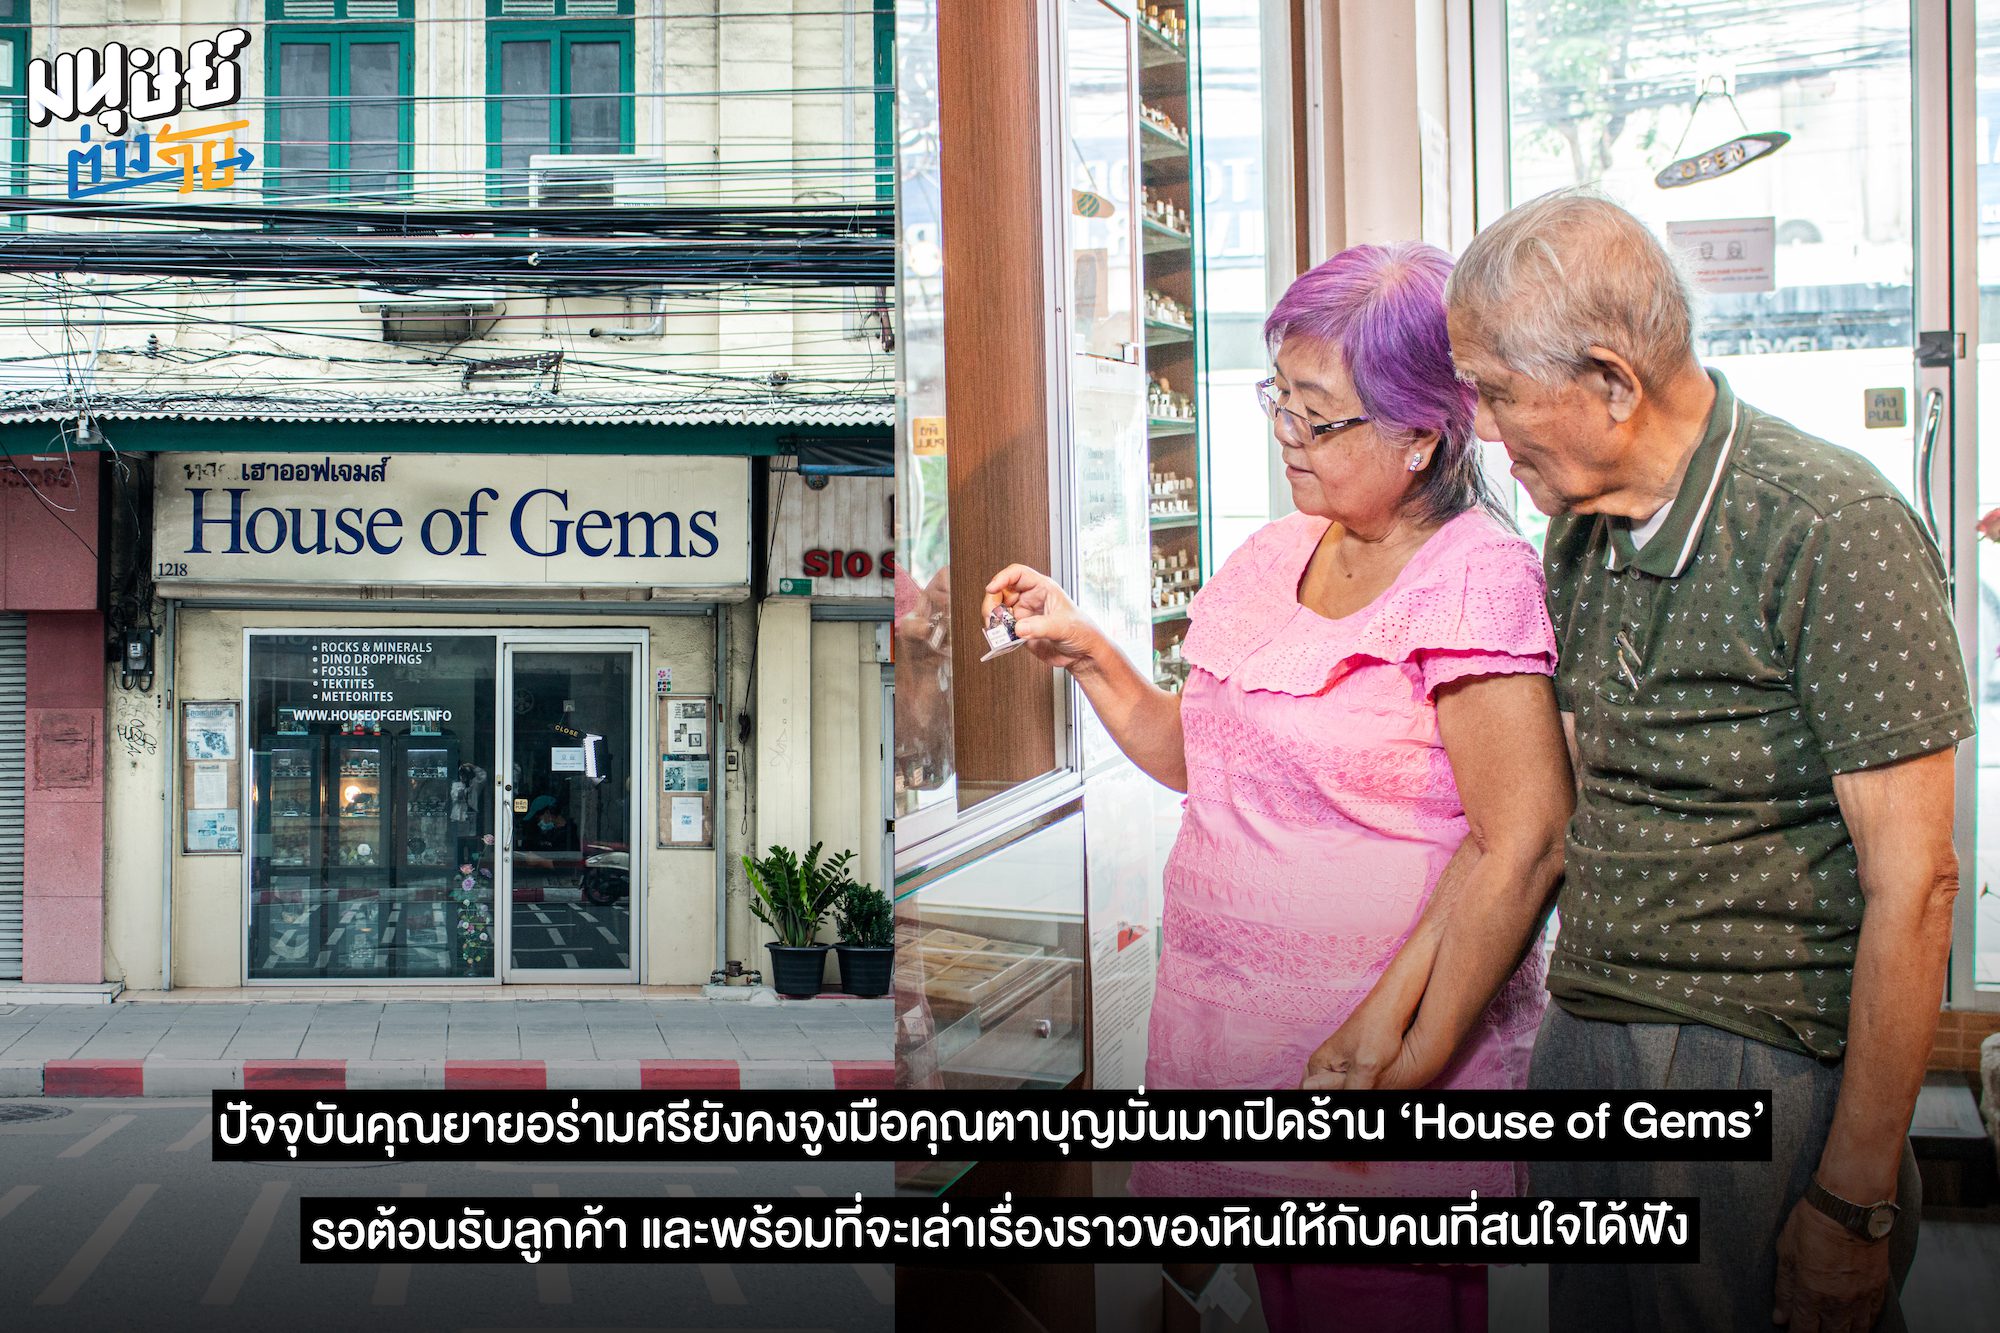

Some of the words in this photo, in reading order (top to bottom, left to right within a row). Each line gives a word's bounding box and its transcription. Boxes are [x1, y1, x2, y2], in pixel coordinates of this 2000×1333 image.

[1681, 143, 1745, 179] OPEN
[1868, 409, 1903, 421] PULL
[241, 456, 391, 483] เฮาออฟเจมส์
[184, 487, 403, 555] House
[420, 487, 500, 556] of
[510, 488, 719, 558] Gems
[158, 563, 188, 577] 1218
[803, 550, 873, 578] SIO
[321, 642, 359, 653] ROCKS
[361, 642, 371, 653] &
[373, 642, 433, 653] MINERALS
[321, 654, 351, 665] DINO
[354, 654, 423, 665] DROPPINGS
[321, 666, 368, 677] FOSSILS
[321, 678, 375, 690] TEKTITES
[321, 691, 394, 702] METEORITES
[293, 709, 453, 722] WWW.HOUSEOFGEMS.INFO
[554, 724, 579, 738] CLOSE
